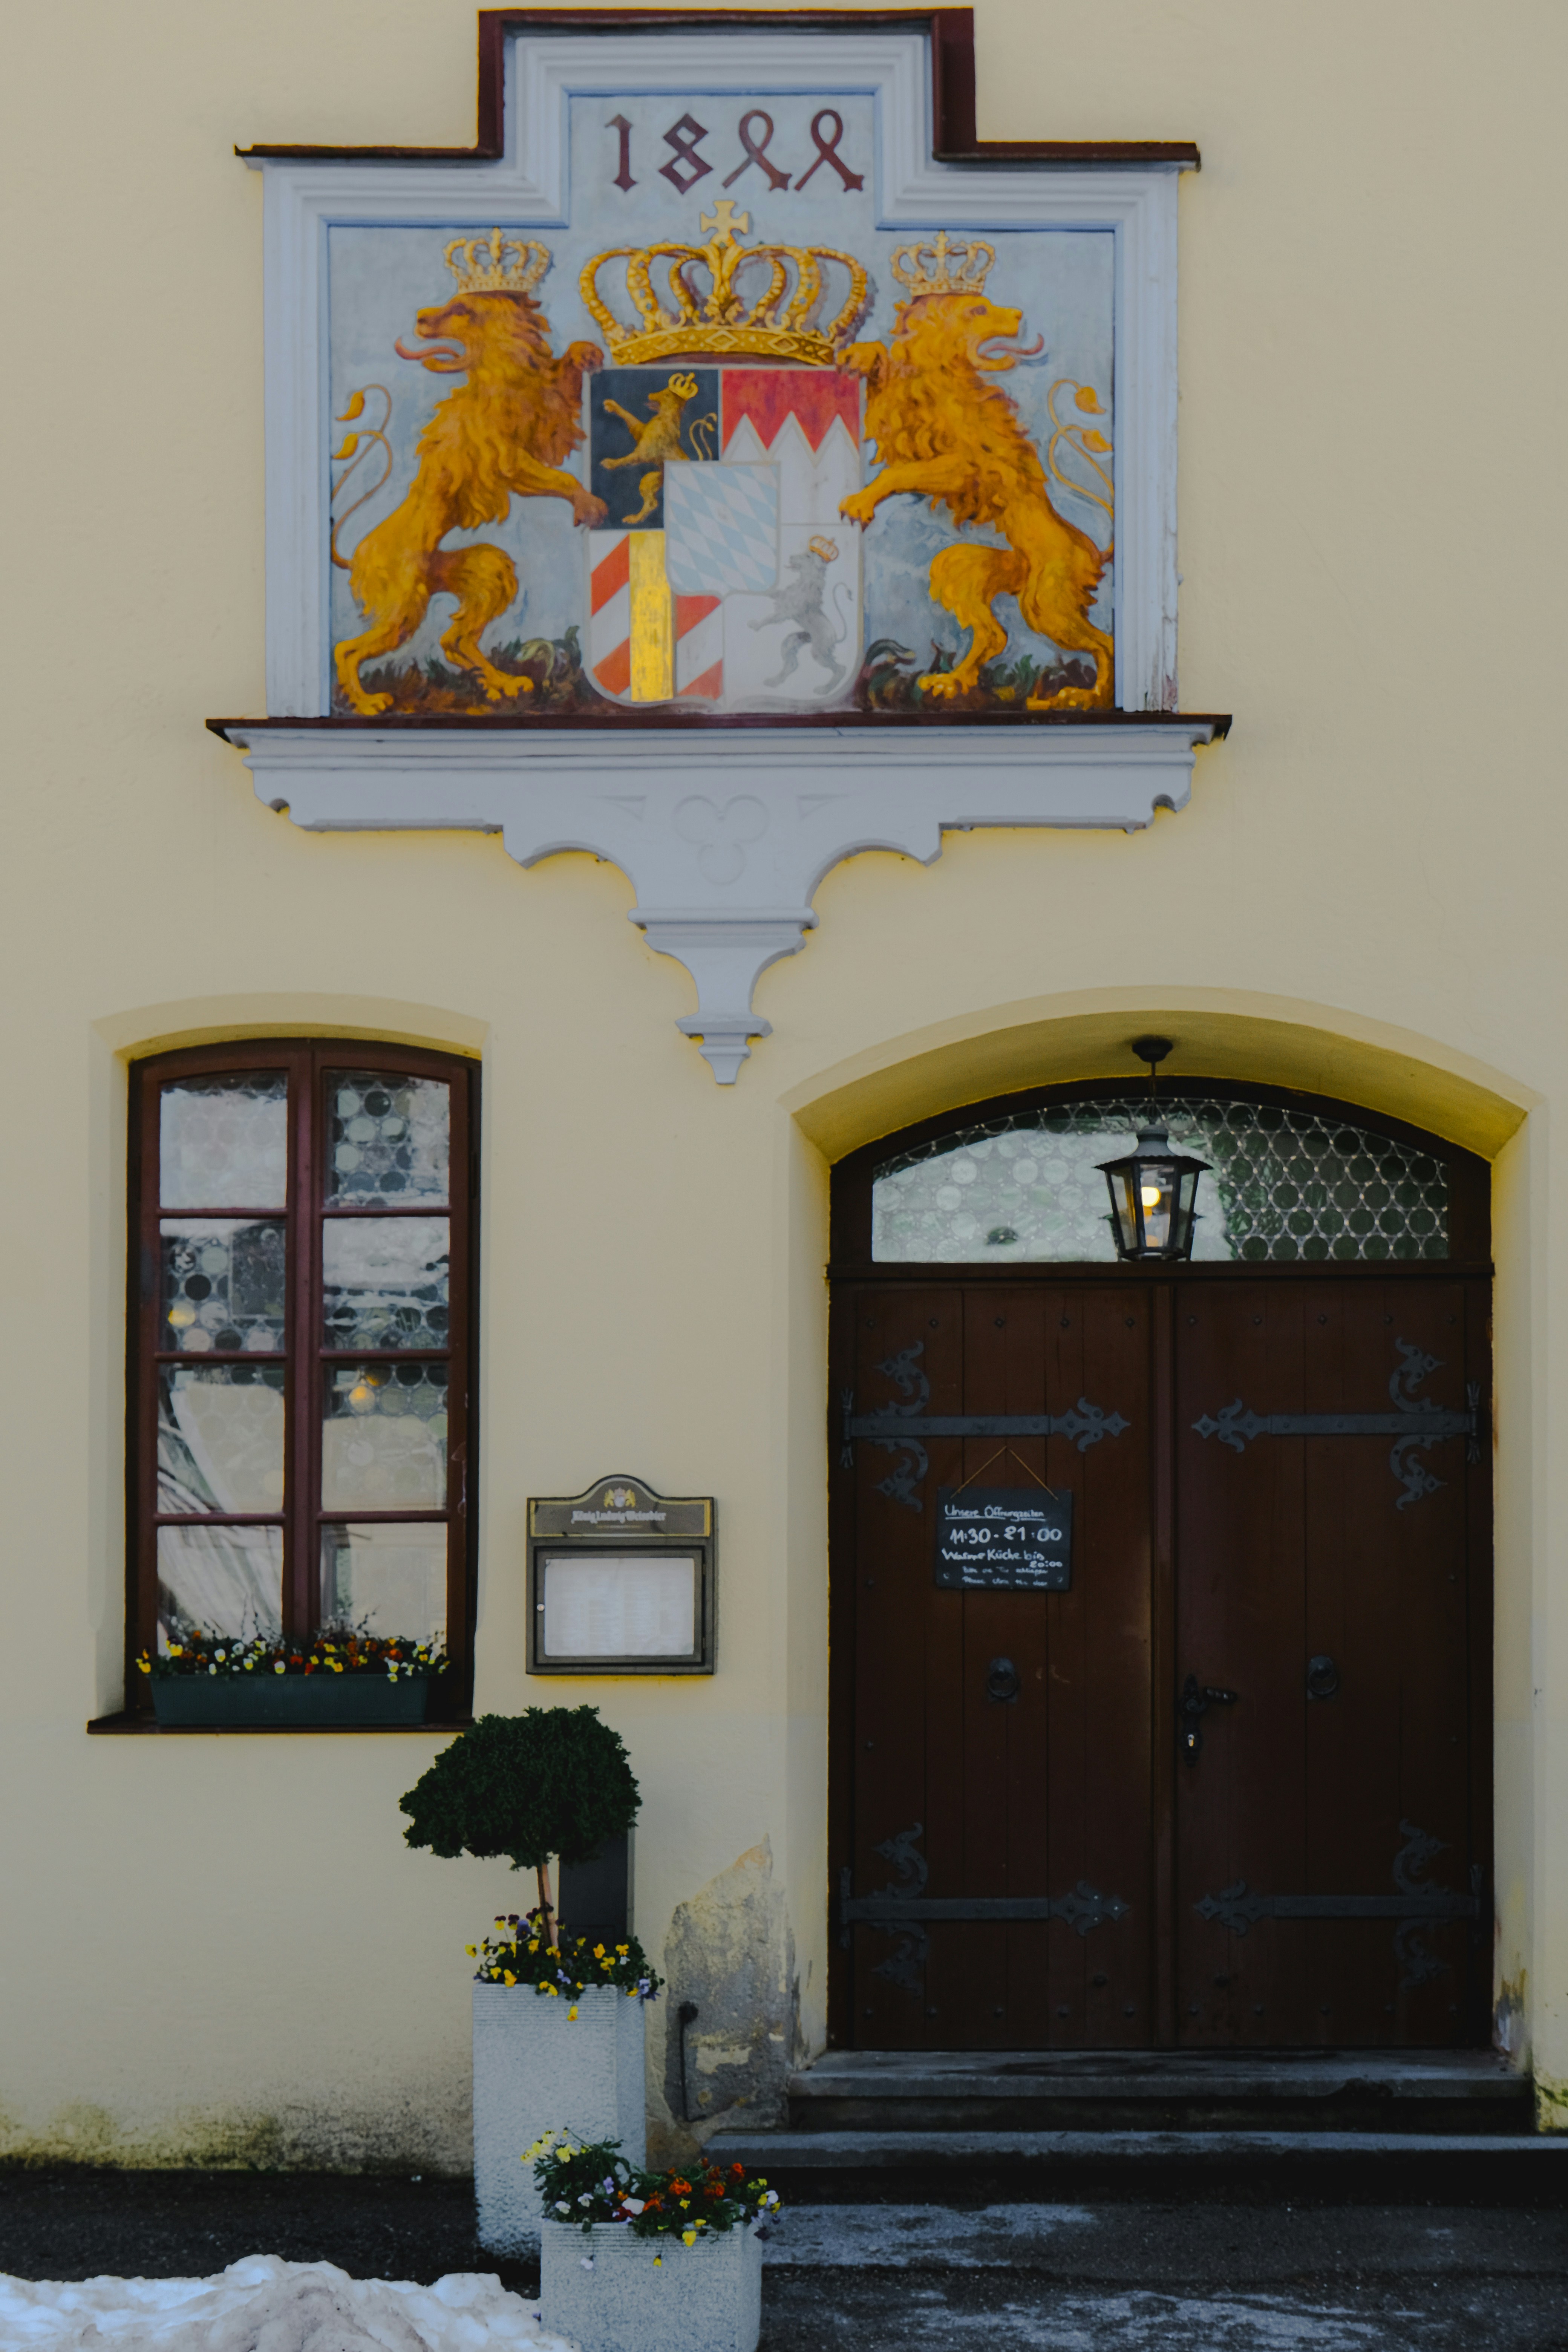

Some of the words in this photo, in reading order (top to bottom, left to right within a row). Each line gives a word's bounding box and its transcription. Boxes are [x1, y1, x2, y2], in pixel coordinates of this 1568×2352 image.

[945, 1504, 979, 1516] Unsere
[571, 1510, 597, 1524] König
[596, 1510, 625, 1524] Ludwig
[950, 1528, 991, 1544] 11:30
[987, 1548, 1022, 1561] Küche
[1023, 1550, 1045, 1561] bis
[1029, 1560, 1063, 1568] 20:00
